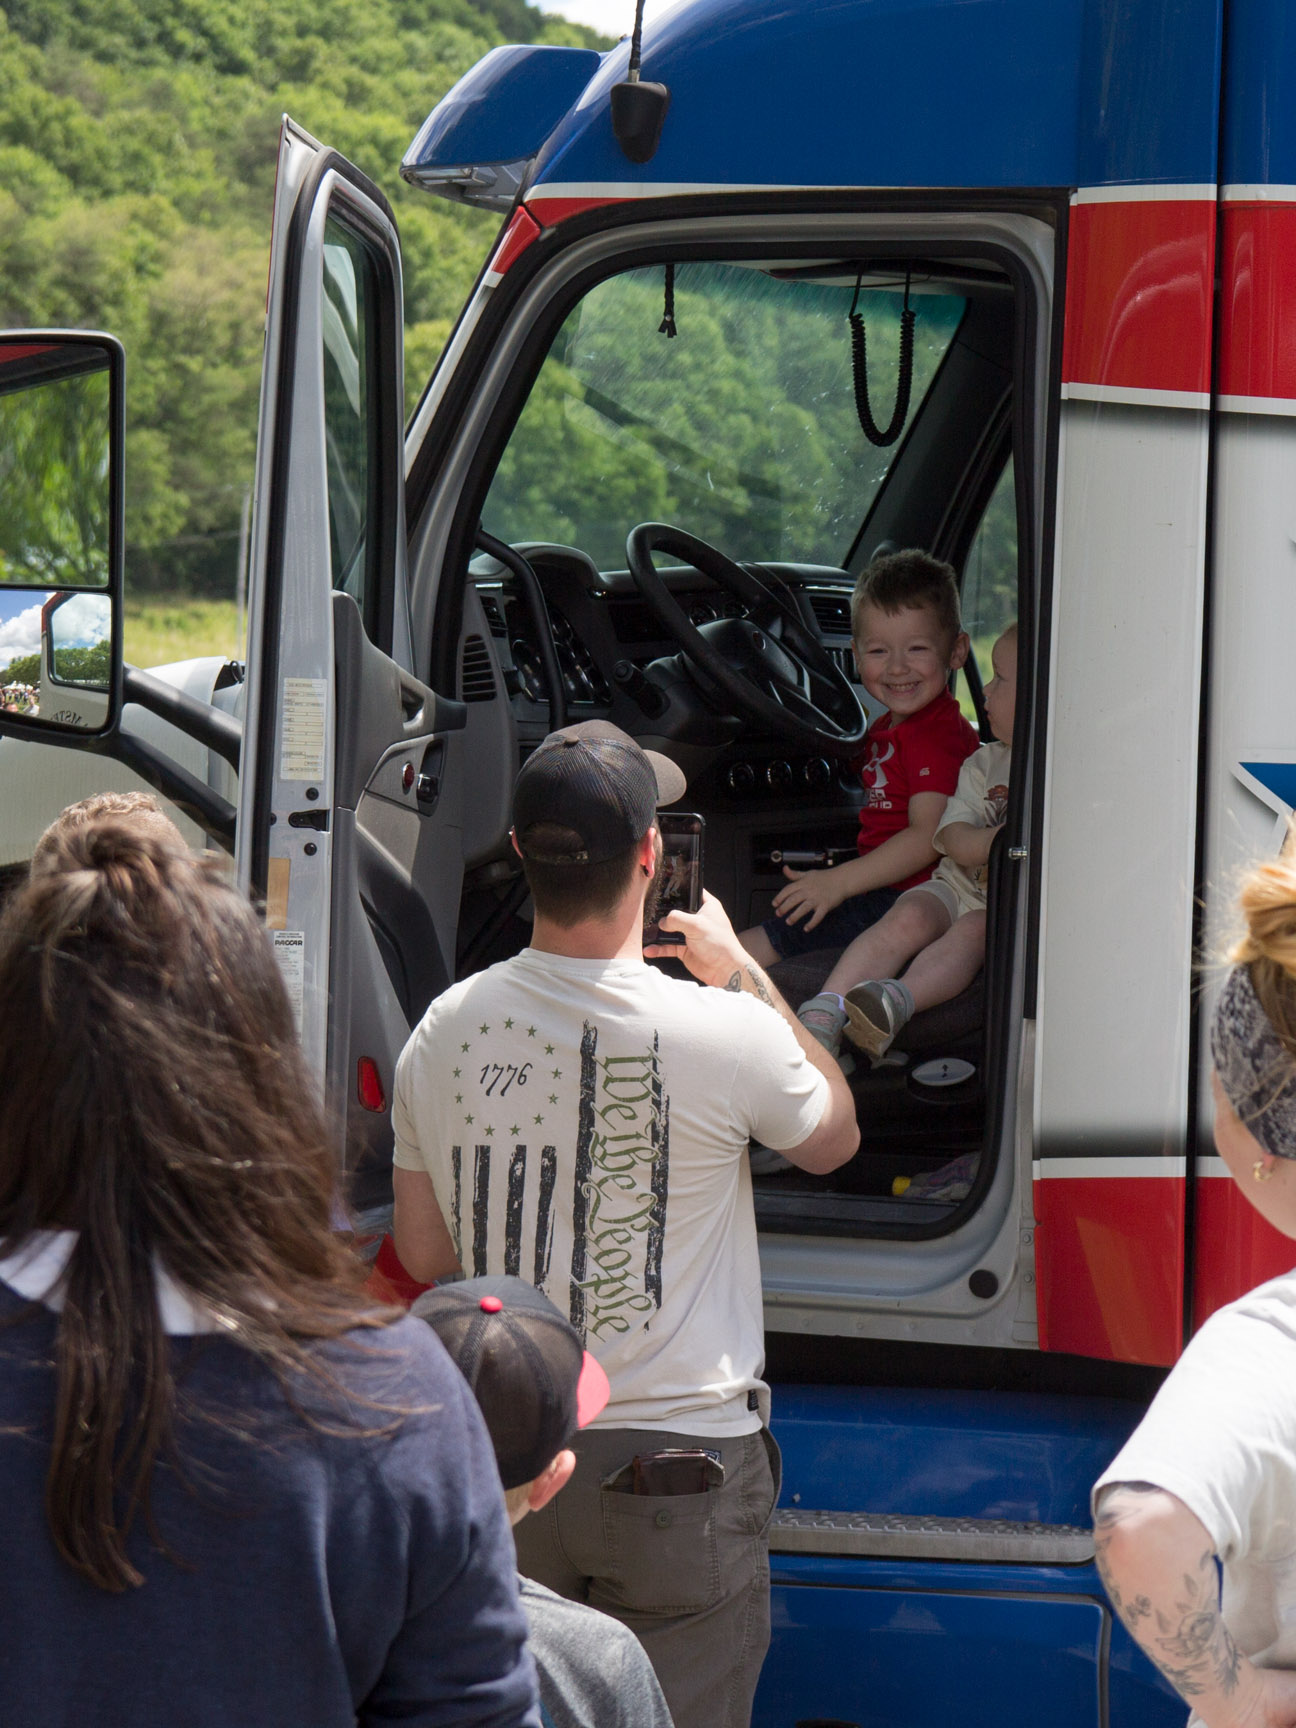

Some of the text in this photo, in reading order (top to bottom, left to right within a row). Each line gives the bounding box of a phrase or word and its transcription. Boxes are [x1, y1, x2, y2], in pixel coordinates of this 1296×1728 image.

[479, 1062, 533, 1097] 1776
[590, 1046, 664, 1131] We
[569, 1181, 660, 1343] People
